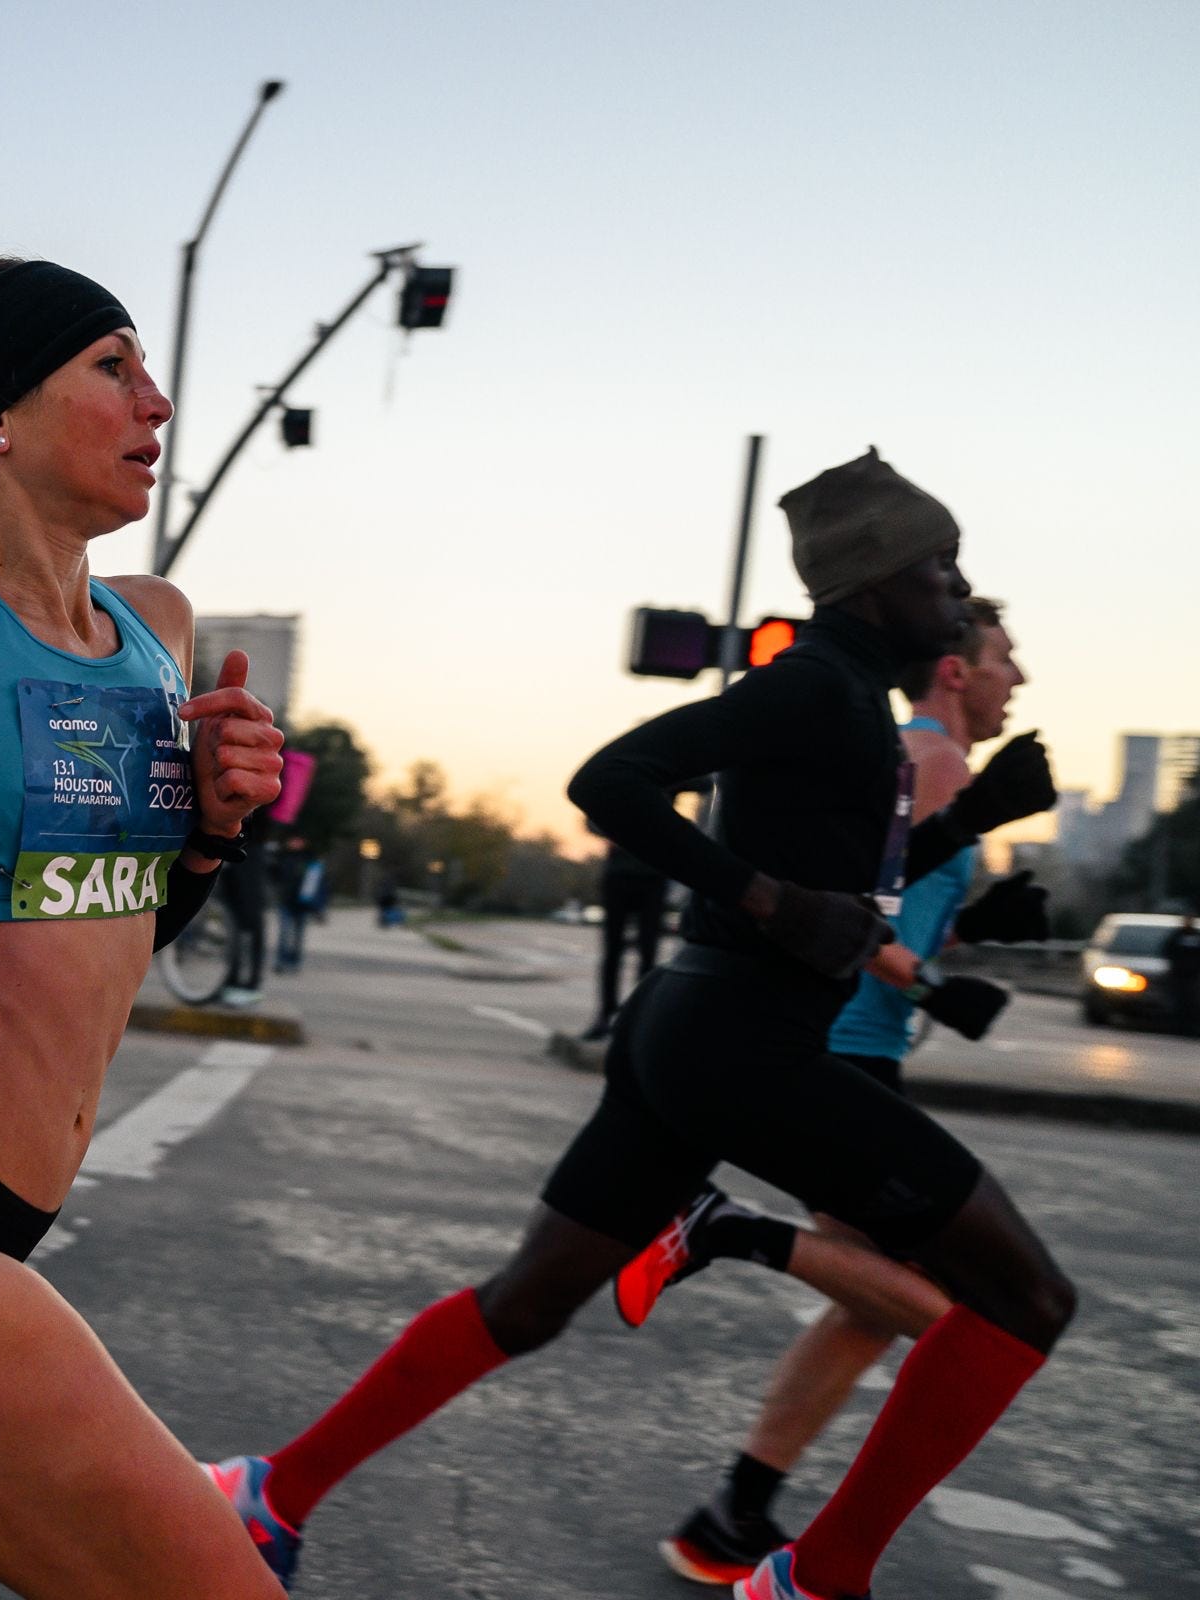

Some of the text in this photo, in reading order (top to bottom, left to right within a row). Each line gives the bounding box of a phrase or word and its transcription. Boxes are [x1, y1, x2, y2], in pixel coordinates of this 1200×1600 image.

[49, 719, 98, 731] aramco
[52, 760, 75, 776] 13.1
[149, 761, 185, 779] JANUARY
[54, 778, 112, 794] HOUSTON
[53, 793, 122, 806] HALF MARATHON
[149, 783, 193, 810] 2022
[39, 855, 162, 916] SARA
